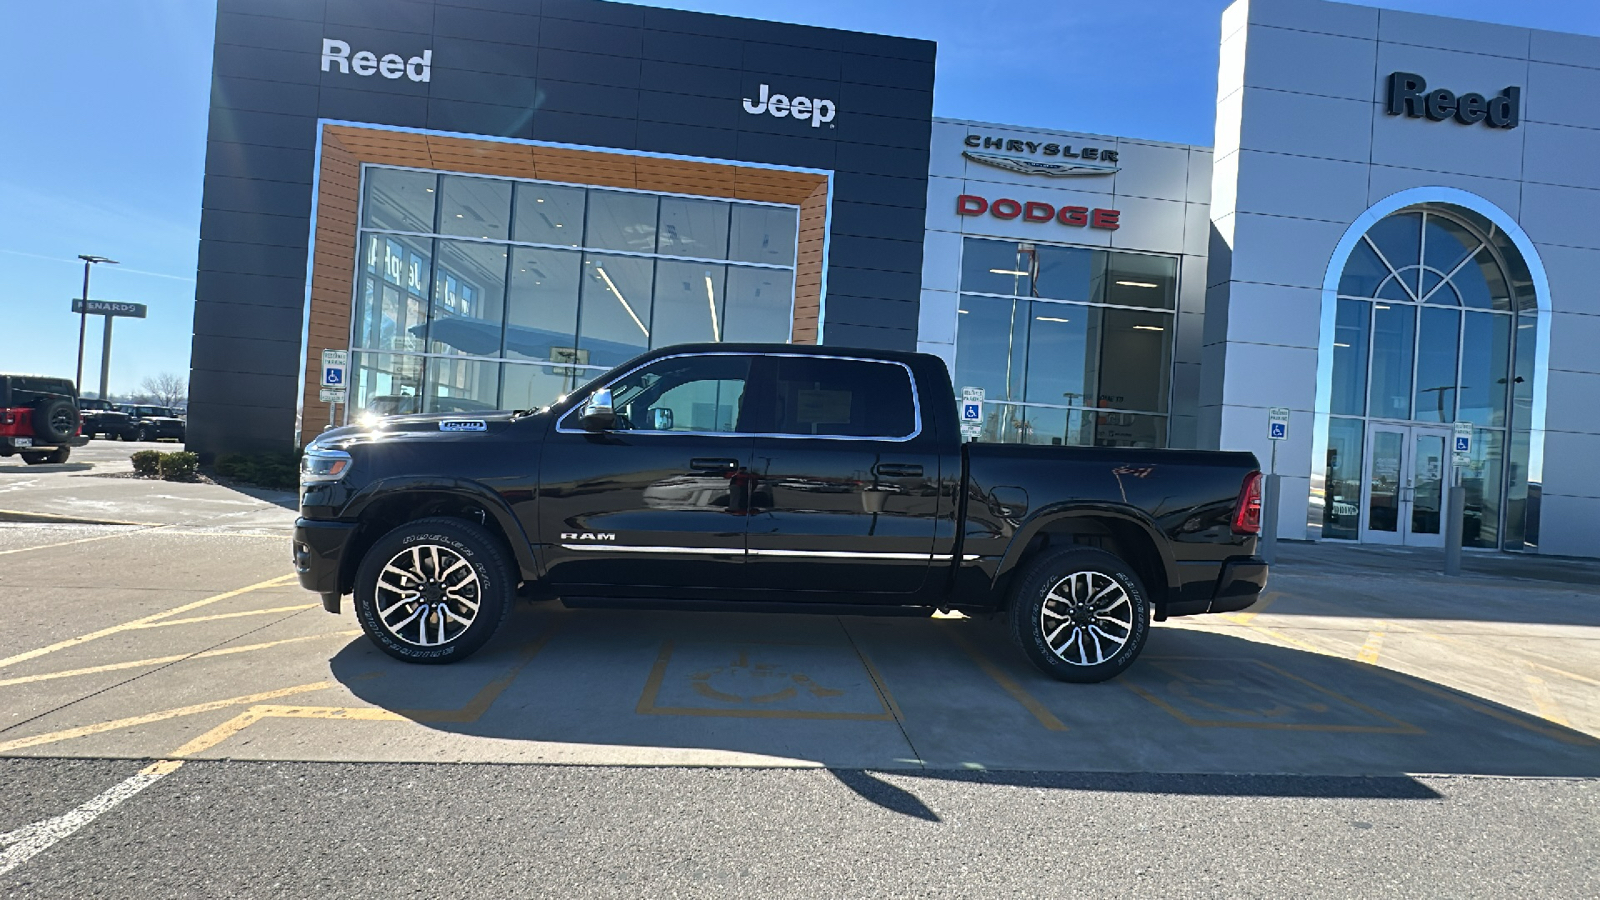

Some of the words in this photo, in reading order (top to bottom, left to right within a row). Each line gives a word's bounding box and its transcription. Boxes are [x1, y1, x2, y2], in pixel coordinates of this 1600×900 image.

[321, 38, 432, 83] Reed
[743, 83, 836, 127] Jeep
[1387, 71, 1521, 130] Reed
[964, 134, 1119, 162] CHRYSLER
[957, 194, 1121, 231] DODGE
[402, 533, 474, 557] DUELER
[560, 532, 616, 541] RAM
